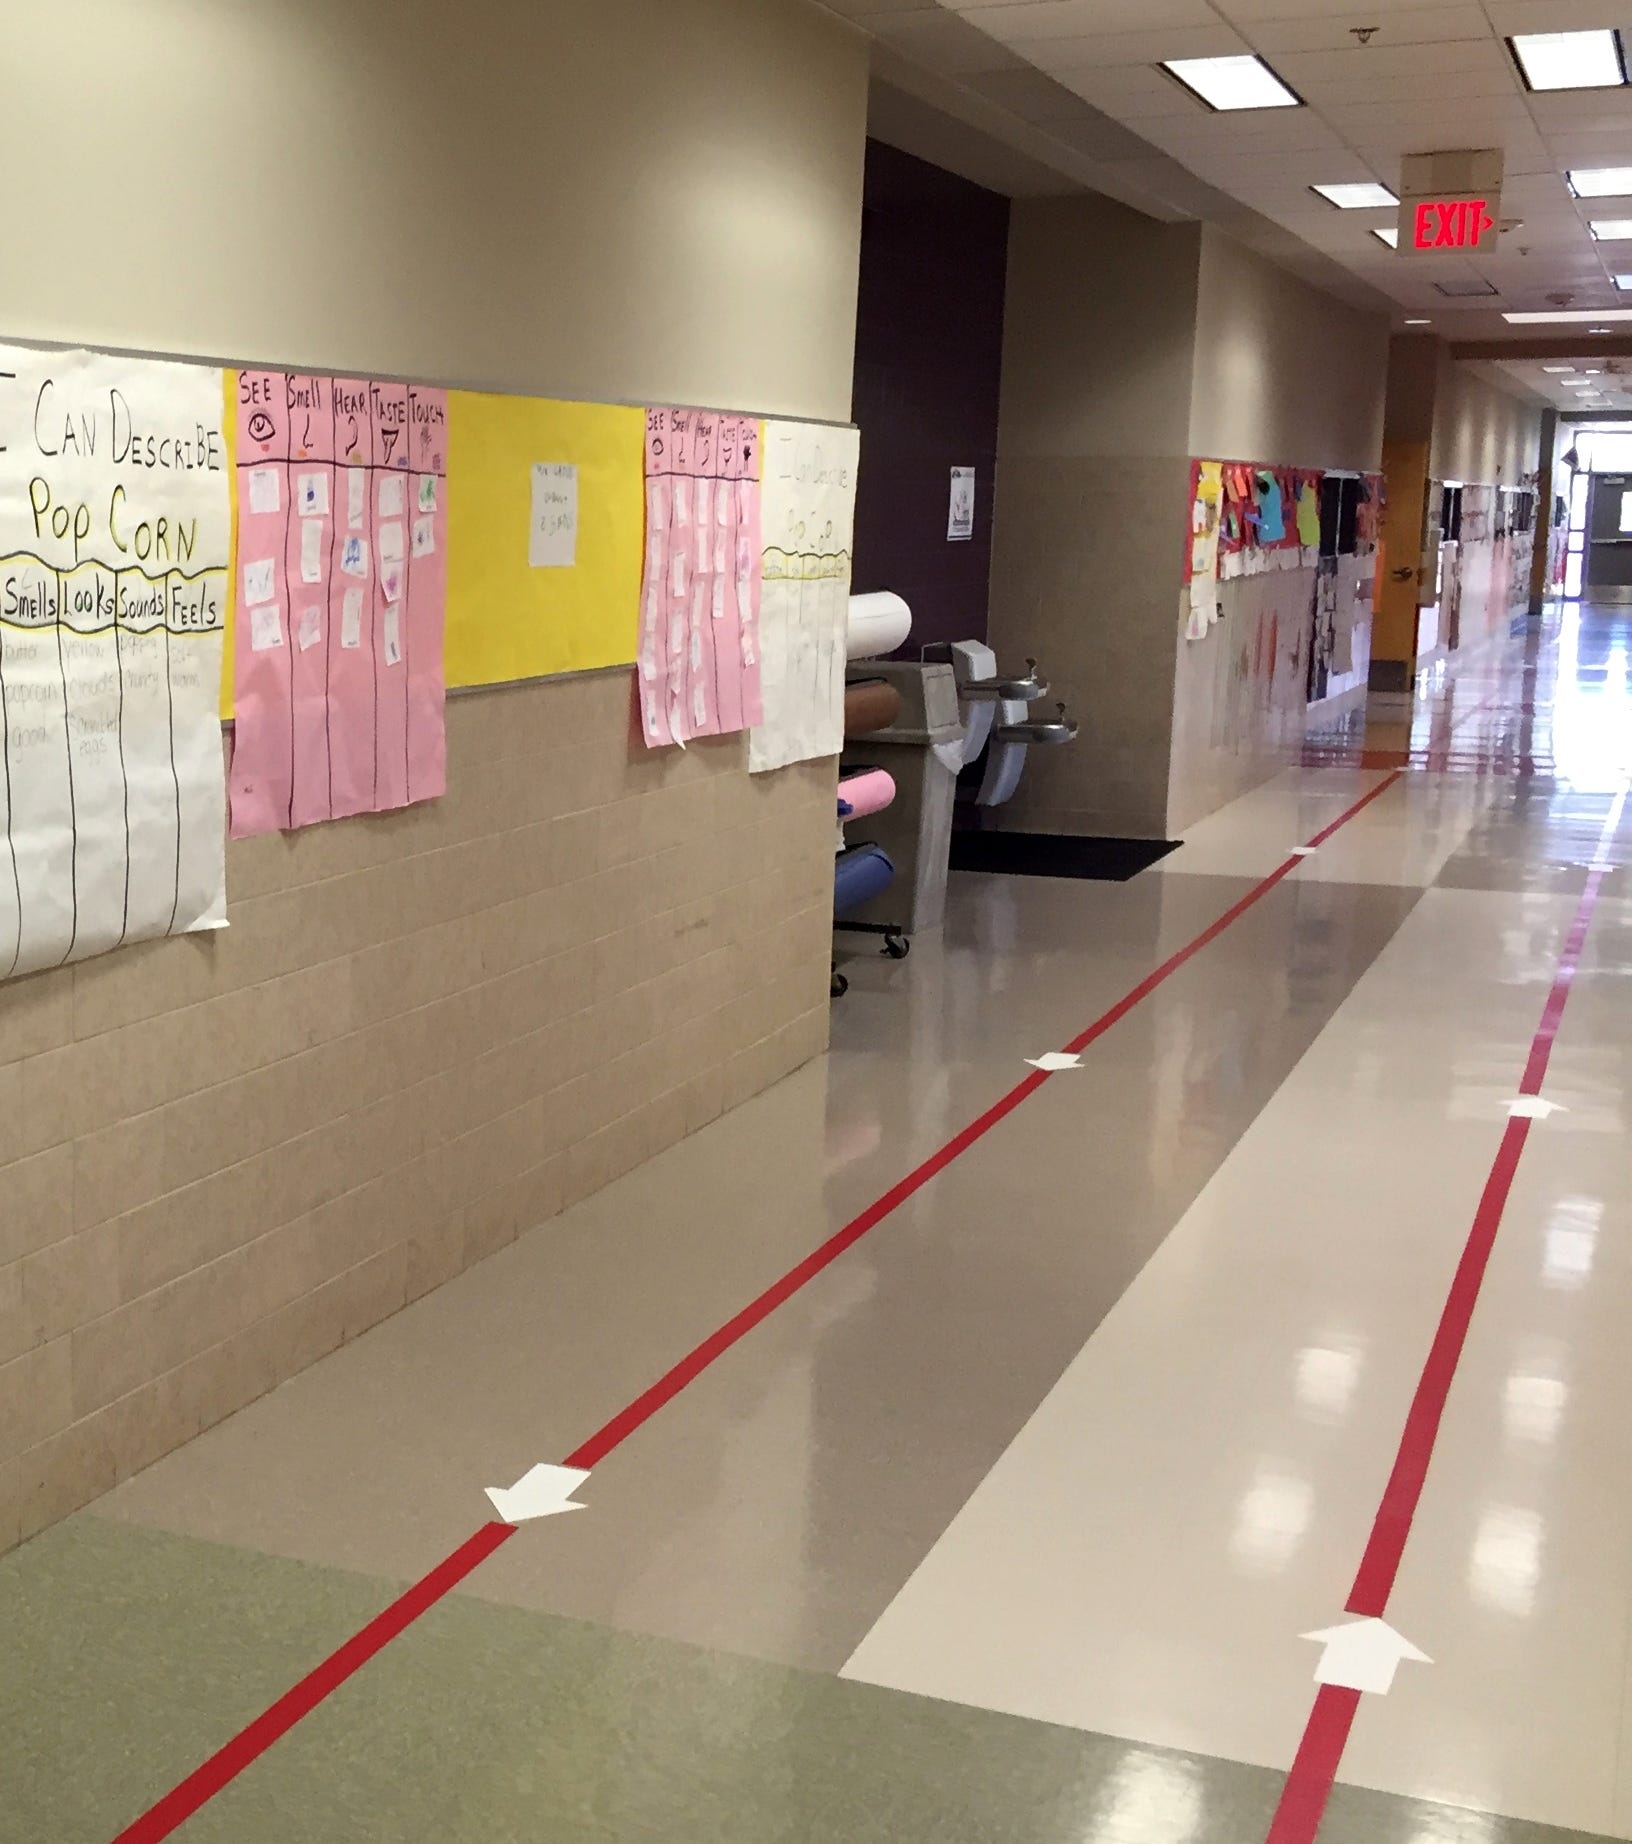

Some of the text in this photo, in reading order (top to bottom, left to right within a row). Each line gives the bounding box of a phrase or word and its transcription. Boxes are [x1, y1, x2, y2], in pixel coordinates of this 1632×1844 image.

[1414, 200, 1486, 248] EXIT
[33, 378, 96, 457] CAN
[110, 388, 220, 471] DESCRIBE
[239, 371, 272, 405] SEE
[334, 387, 368, 418] HEAR
[372, 388, 407, 424] TASTE
[409, 392, 445, 425] TOUCH
[110, 484, 197, 563] CORN
